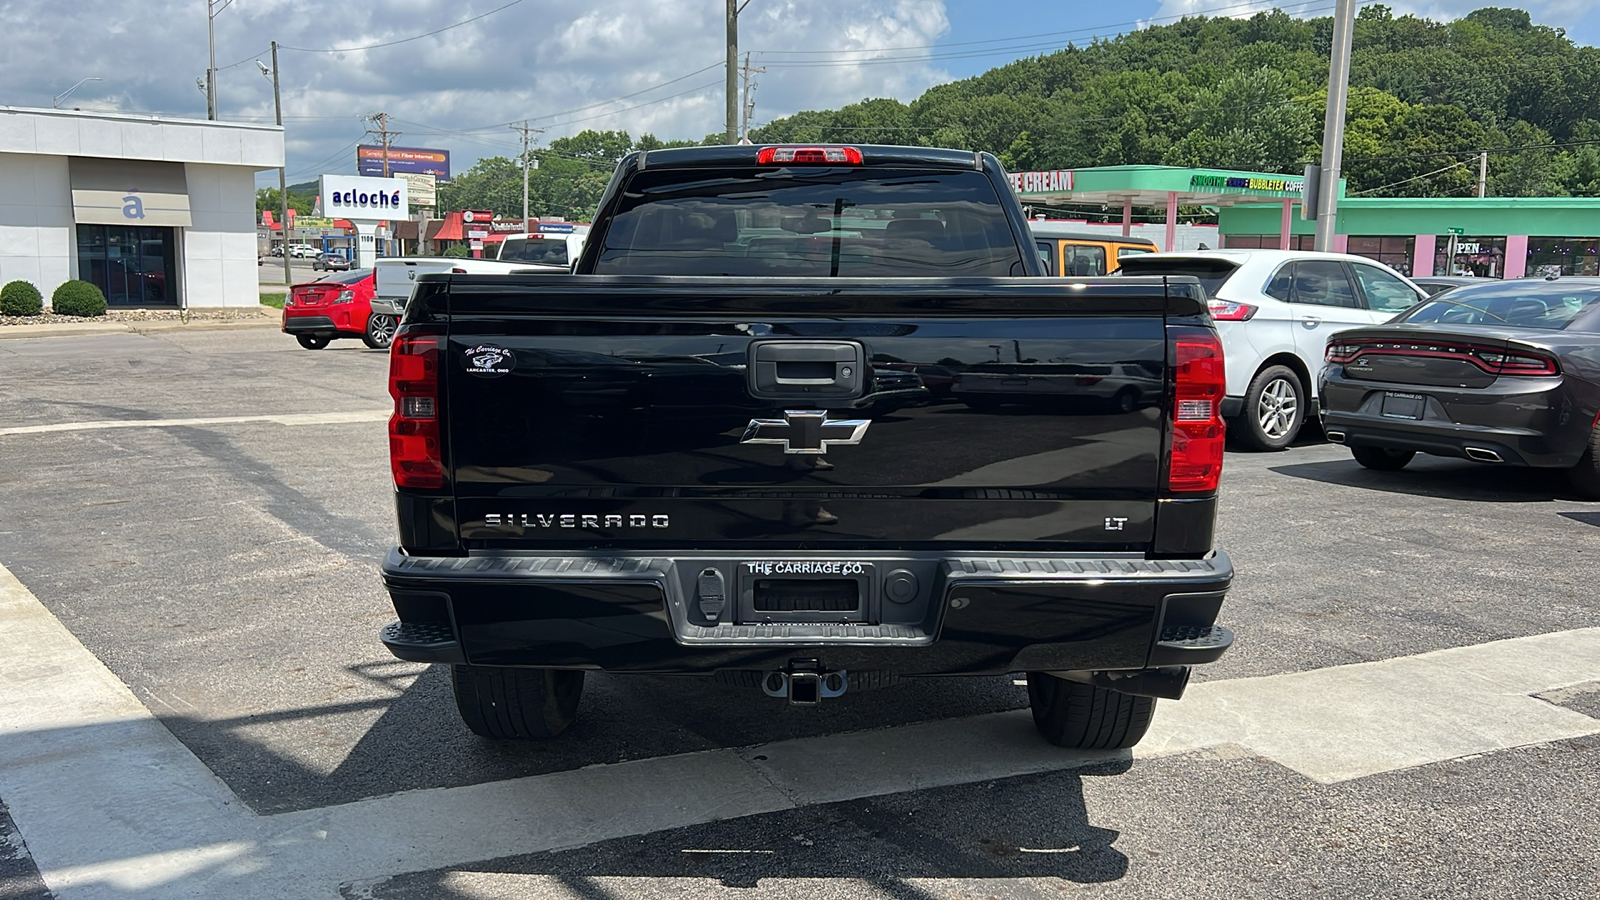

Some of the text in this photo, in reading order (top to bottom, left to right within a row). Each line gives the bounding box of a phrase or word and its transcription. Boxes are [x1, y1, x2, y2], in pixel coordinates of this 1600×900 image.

[1025, 171, 1073, 192] CREAM
[1285, 180, 1304, 192] COFFE
[333, 188, 400, 207] acloché
[1457, 243, 1480, 254] PEN
[476, 345, 501, 354] Carriage
[1377, 344, 1456, 353] DODGE
[485, 513, 669, 528] SILVERADO
[1105, 517, 1128, 530] LT
[747, 563, 865, 574] THE CARRIAGE CO.
